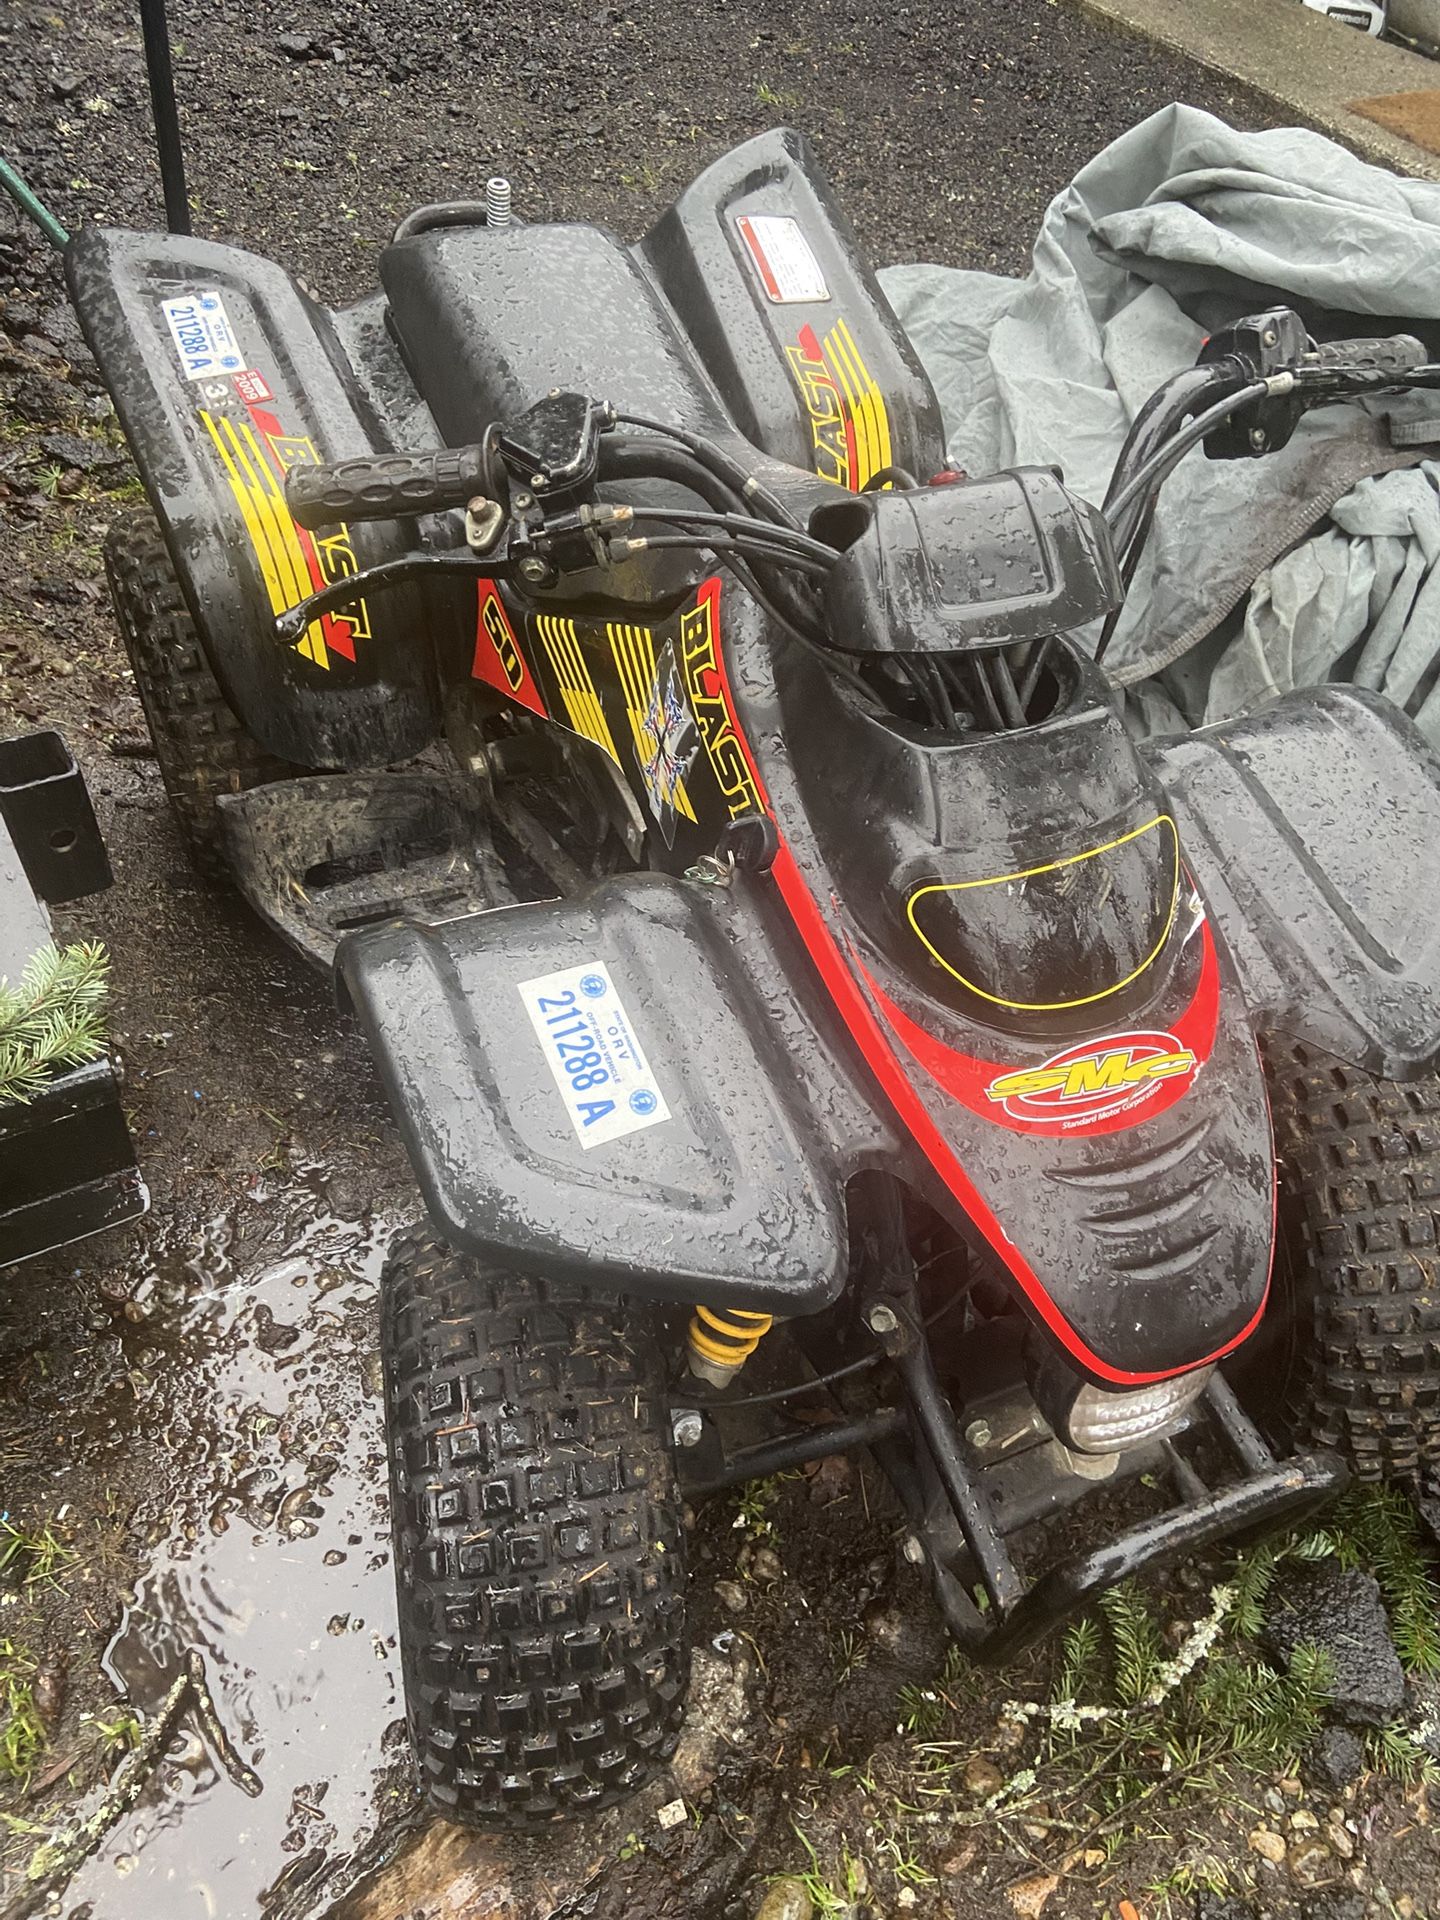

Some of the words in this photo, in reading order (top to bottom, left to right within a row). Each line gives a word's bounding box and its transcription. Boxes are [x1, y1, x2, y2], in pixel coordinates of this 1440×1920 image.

[170, 306, 209, 354] 211288
[187, 358, 212, 370] A
[235, 374, 259, 400] 2009
[785, 345, 850, 491] LAST
[265, 432, 372, 639] BST
[482, 595, 524, 692] 50
[680, 597, 766, 821] BLAST
[537, 990, 609, 1091] 211288
[576, 1100, 616, 1127] A
[586, 1012, 607, 1050] OFF-ROAD
[603, 1051, 622, 1084] VEHICLE
[607, 1026, 630, 1059] ORV
[985, 1050, 1197, 1101] SMC
[1061, 1114, 1097, 1130] Standard
[1098, 1107, 1121, 1122] Motor
[1122, 1082, 1163, 1112] Corporation
